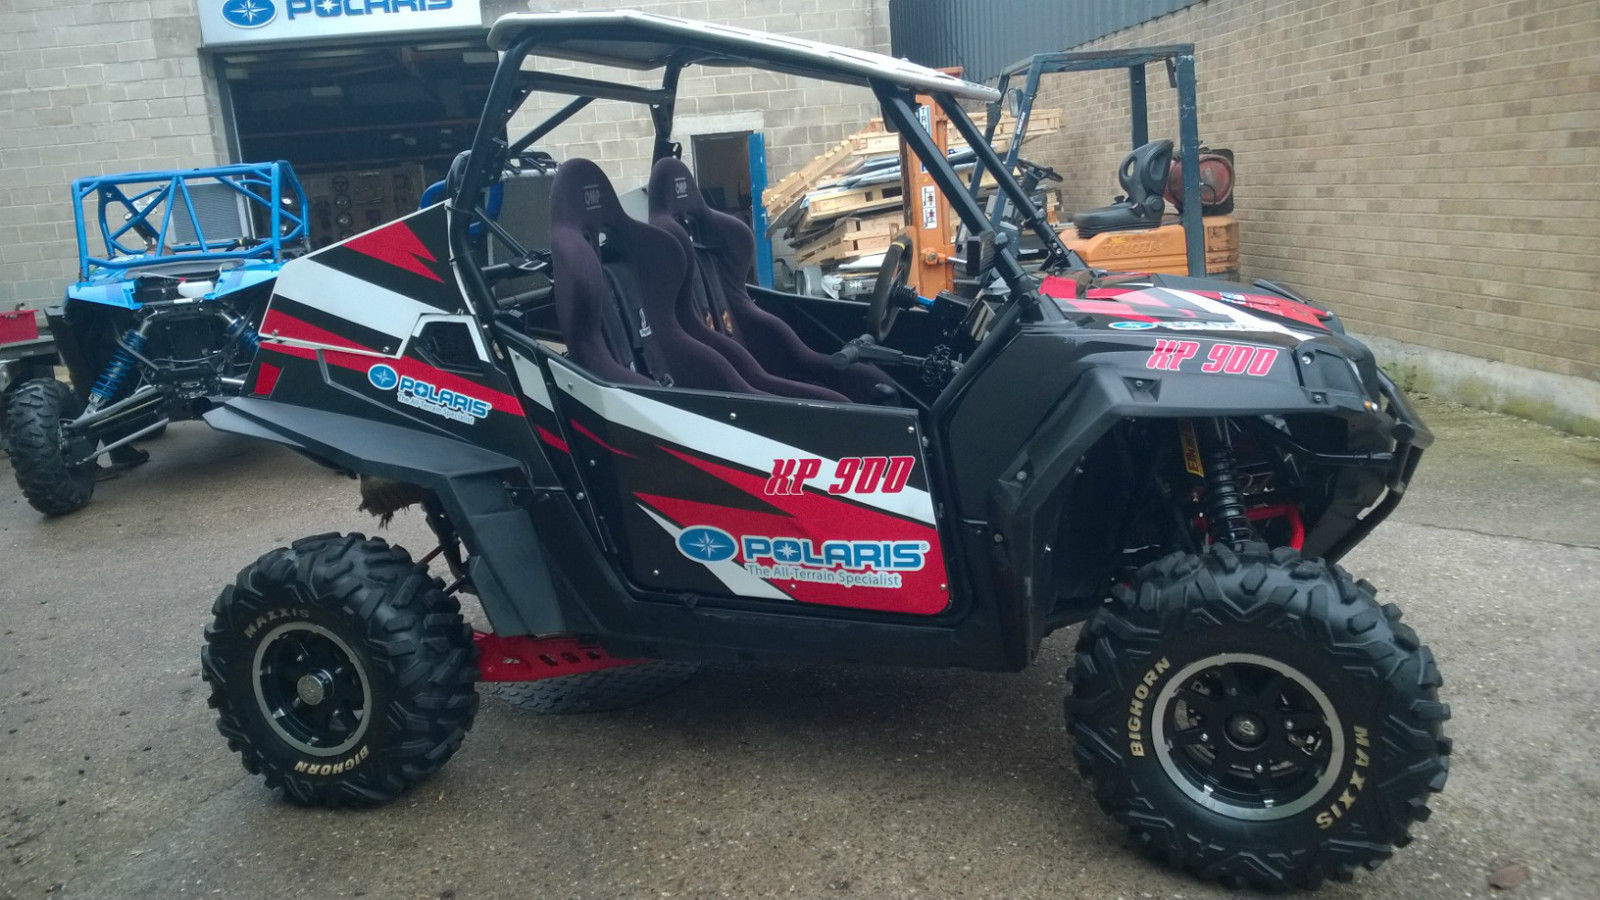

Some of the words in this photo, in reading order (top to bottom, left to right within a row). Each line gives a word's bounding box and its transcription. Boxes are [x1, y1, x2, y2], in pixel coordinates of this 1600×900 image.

[1146, 339, 1199, 371] XP
[1201, 343, 1278, 376] 900
[399, 376, 489, 418] POLARIS
[764, 458, 822, 495] XP
[828, 456, 915, 494] 900
[744, 537, 923, 569] POLARIS
[748, 565, 770, 577] The
[773, 567, 835, 582] All-Terrain
[838, 571, 901, 587] Specialist
[244, 607, 310, 638] MAXXIS
[1128, 656, 1171, 757] BIGHORN
[294, 744, 370, 776] BIGHORN
[1315, 725, 1370, 829] MAXXIS
